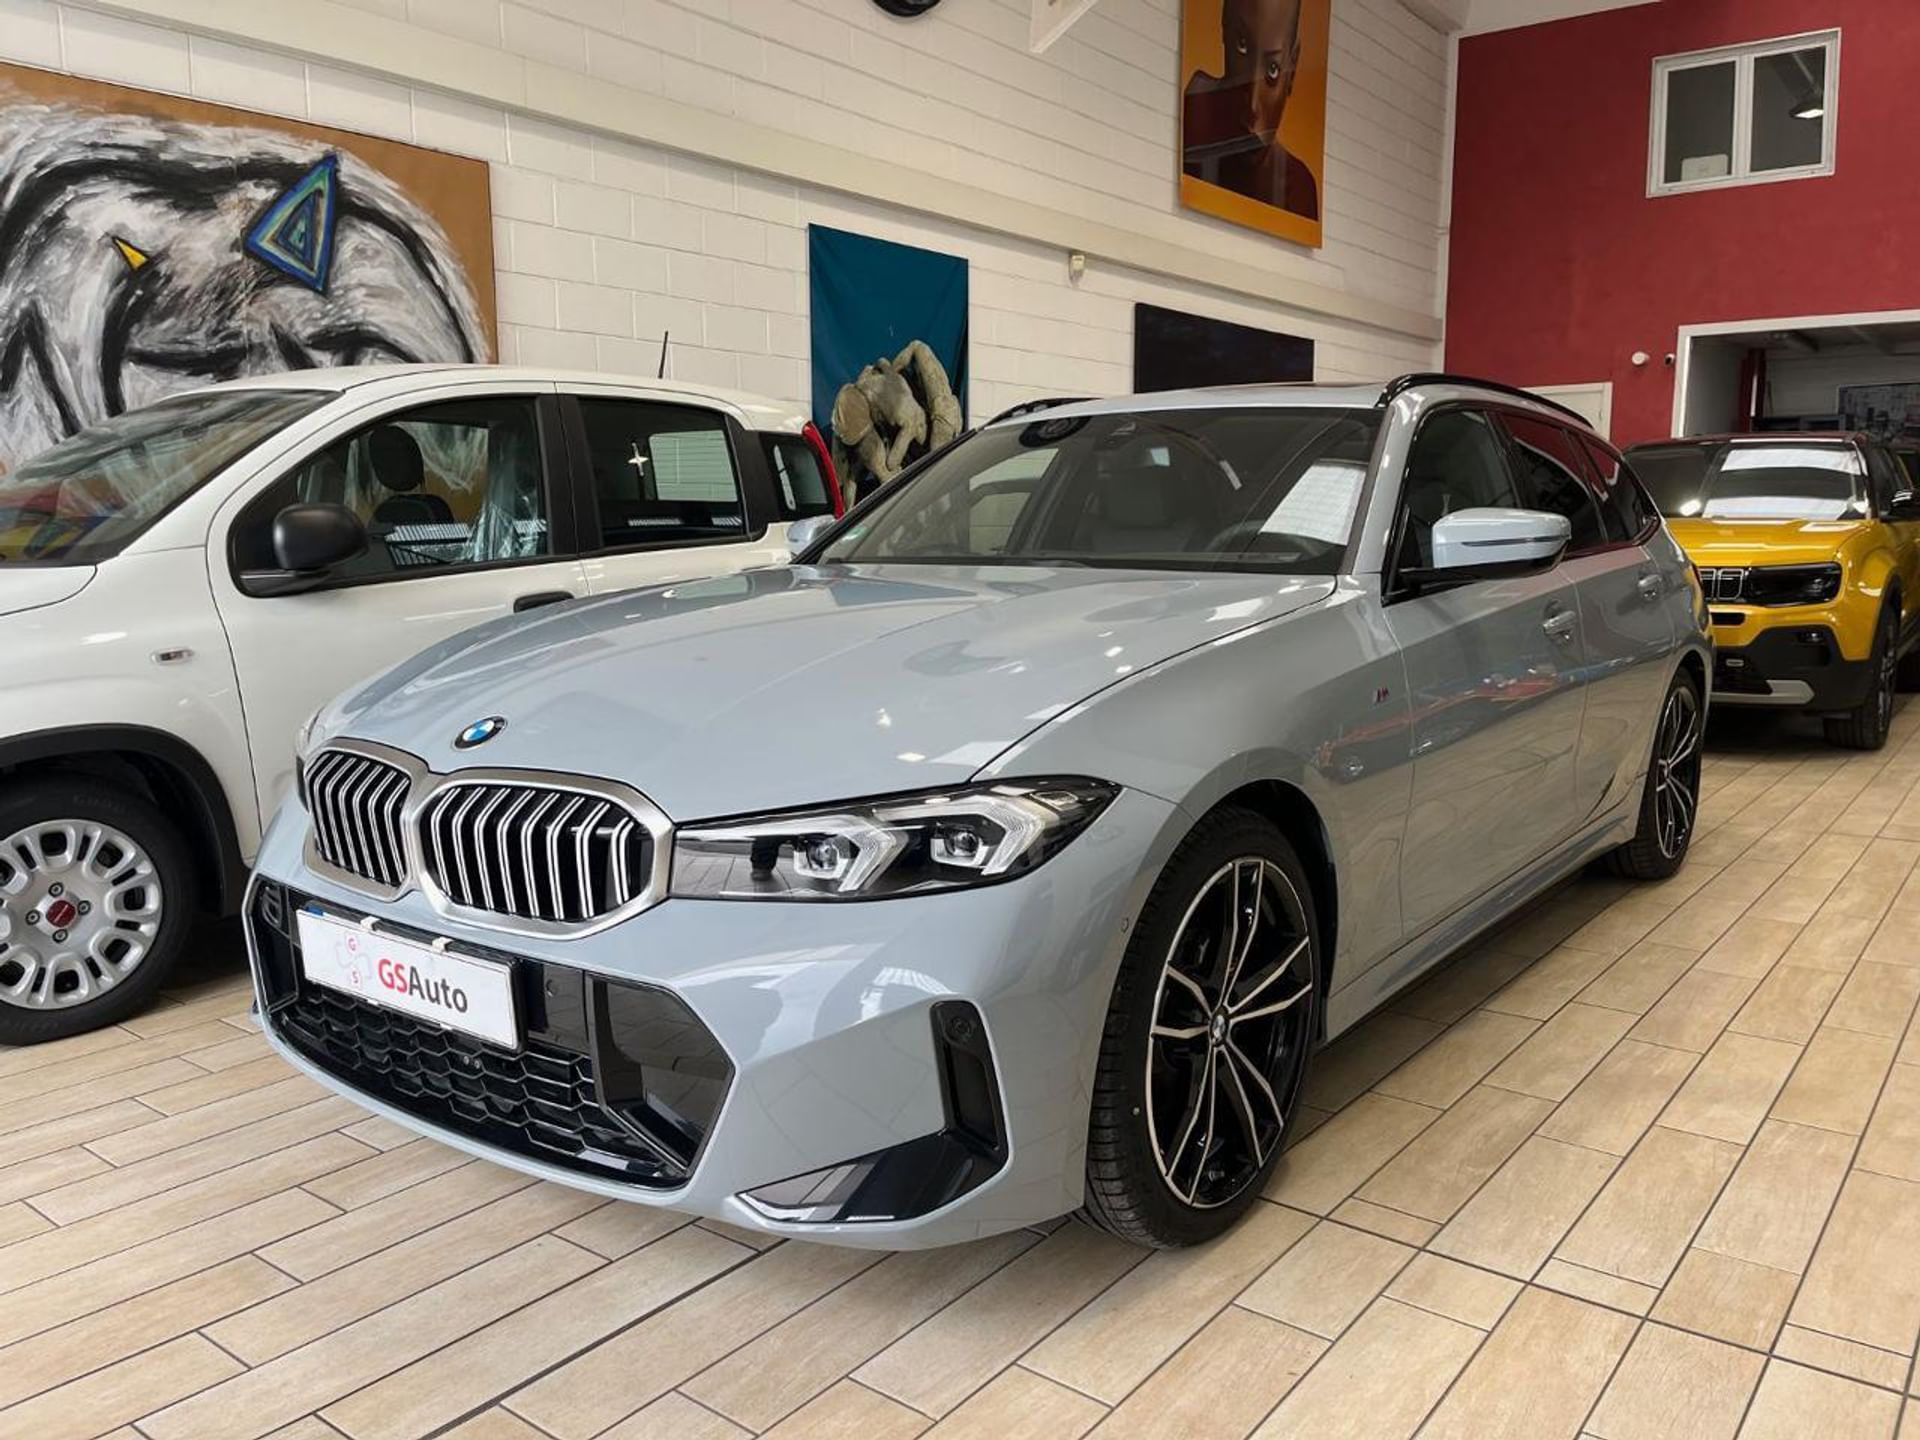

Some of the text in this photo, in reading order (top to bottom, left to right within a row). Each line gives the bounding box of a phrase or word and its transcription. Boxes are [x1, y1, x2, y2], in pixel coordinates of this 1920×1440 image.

[348, 938, 356, 951] G
[352, 970, 359, 984] S
[378, 958, 468, 1013] GSAuto
